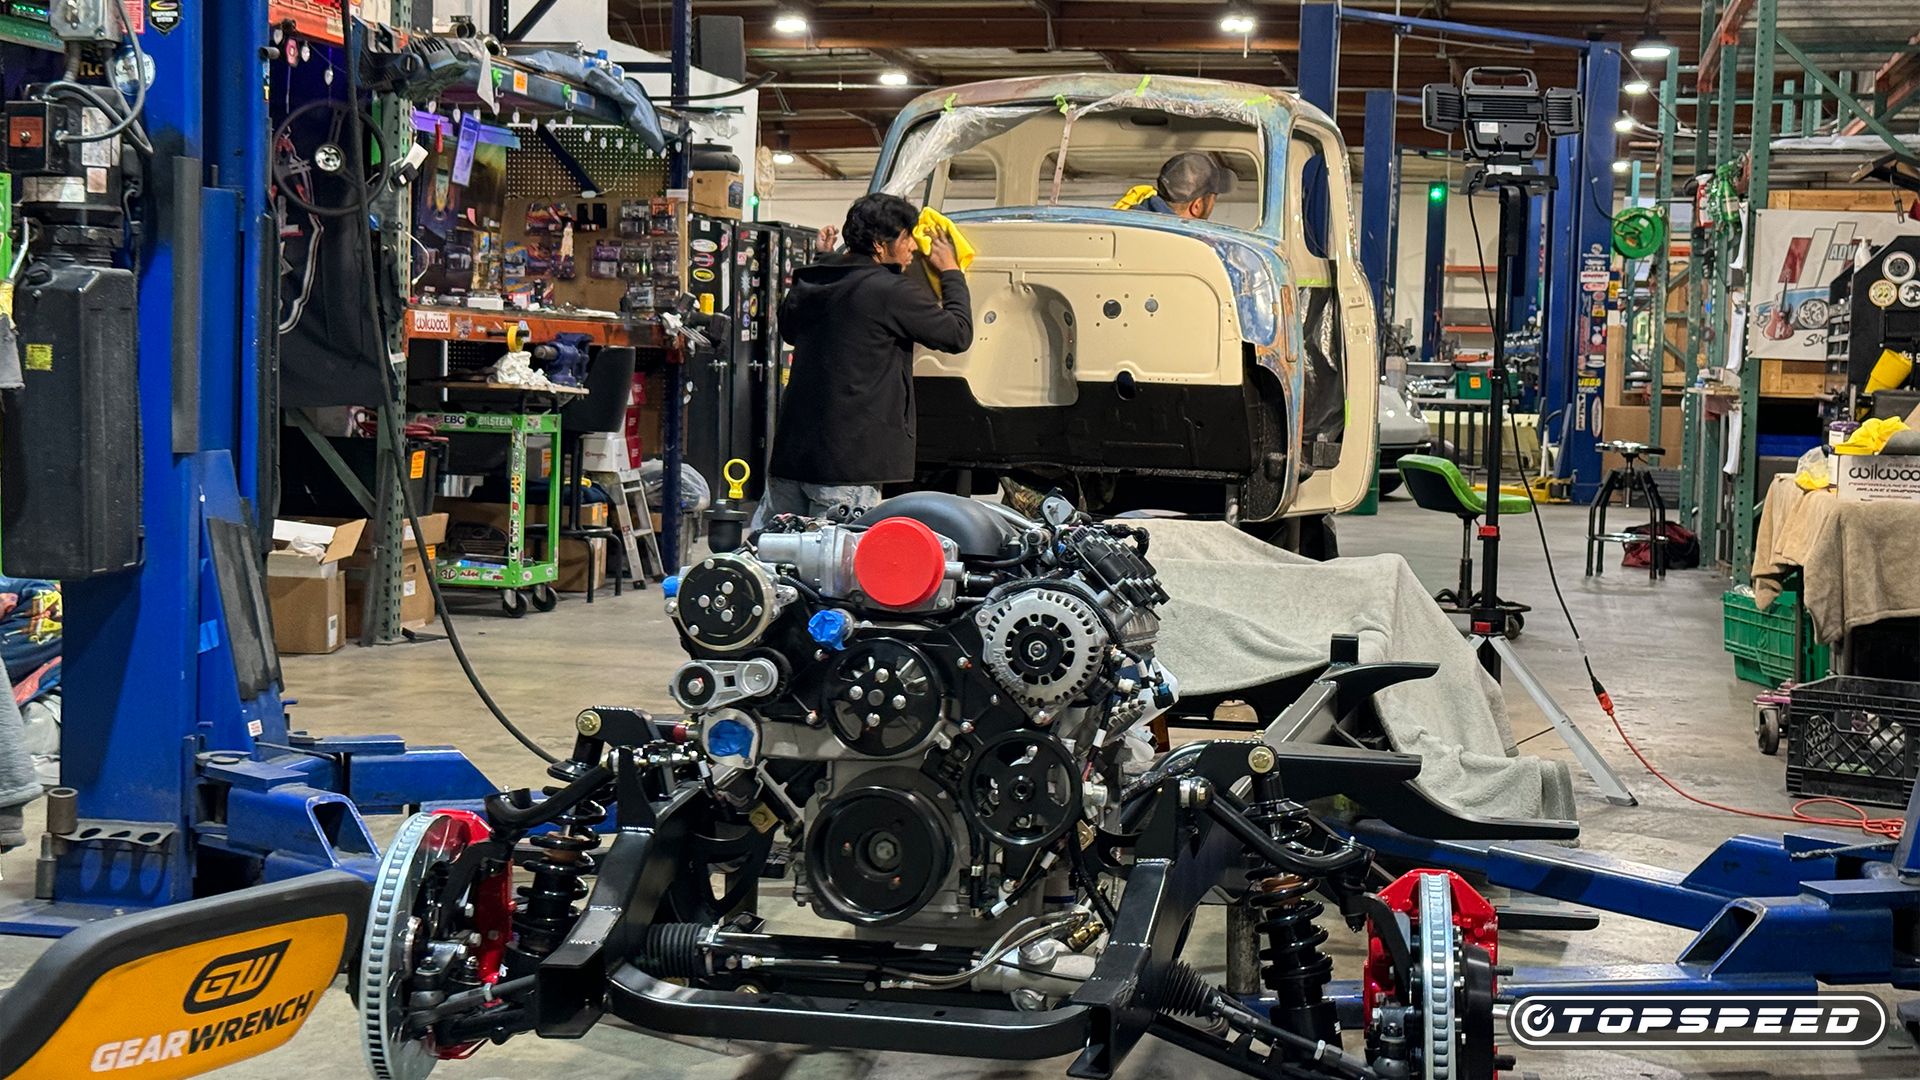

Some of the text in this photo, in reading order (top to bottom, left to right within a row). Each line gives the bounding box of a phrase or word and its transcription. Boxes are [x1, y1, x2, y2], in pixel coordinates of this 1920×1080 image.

[444, 415, 465, 425] EBC
[478, 416, 513, 426] BILSTEIN
[90, 990, 314, 1073] GEARWRENCH
